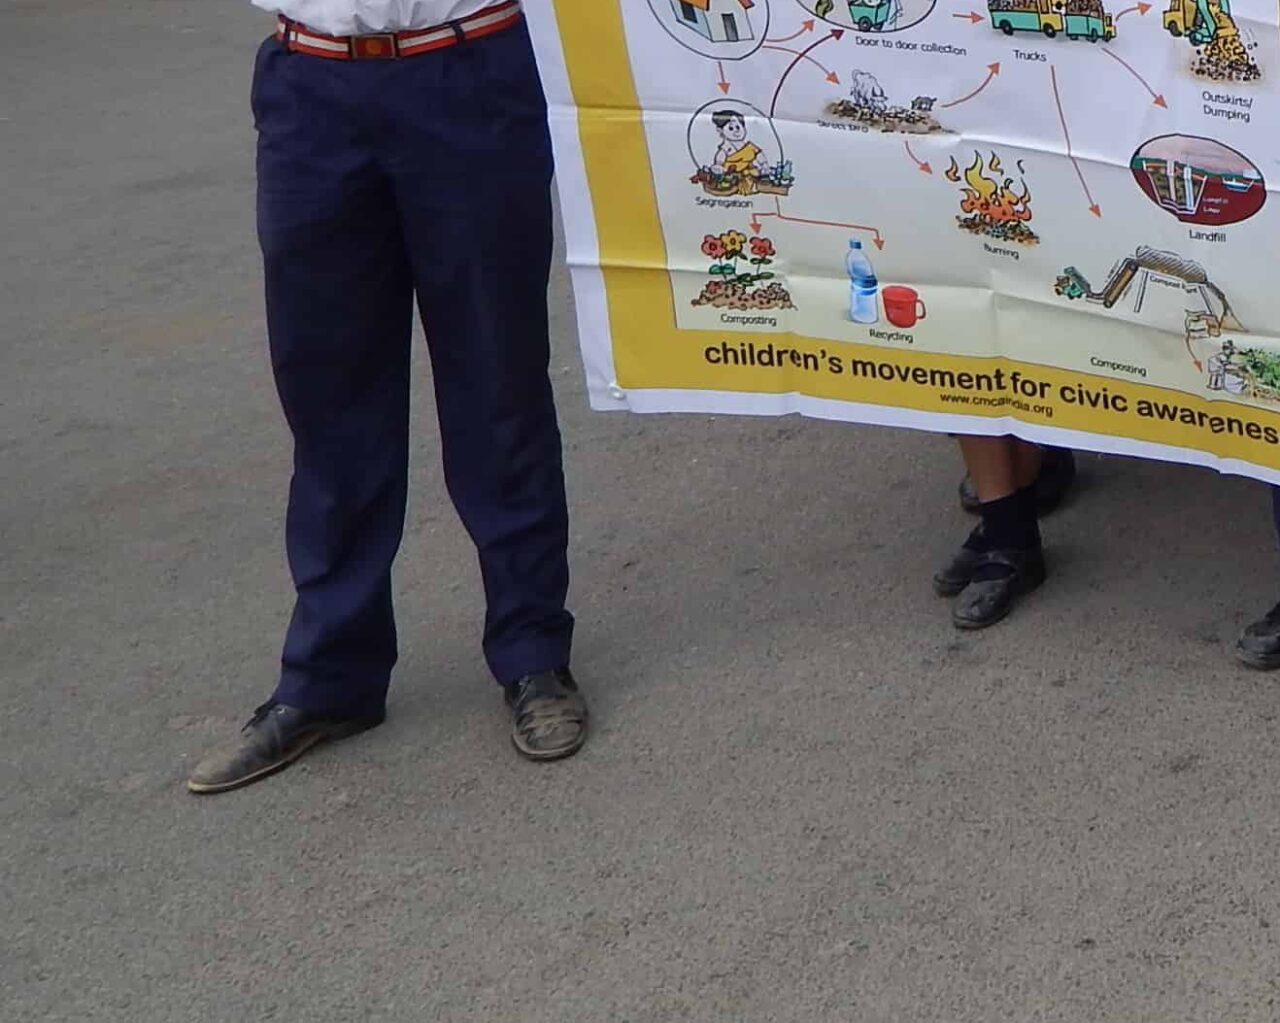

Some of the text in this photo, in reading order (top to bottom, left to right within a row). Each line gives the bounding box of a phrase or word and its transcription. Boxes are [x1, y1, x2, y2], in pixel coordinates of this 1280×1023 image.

[855, 35, 968, 57] Door to door collection
[1013, 49, 1048, 63] Trucks
[1202, 89, 1253, 109] Outskirts/
[1203, 104, 1251, 123] Dumping
[695, 195, 754, 210] Segregation
[1188, 228, 1227, 243] Landfill
[720, 313, 778, 328] Composting
[868, 328, 915, 345] Recycling
[1090, 356, 1148, 377] Composting
[704, 341, 844, 376] children's
[851, 357, 1006, 392] movement
[1010, 369, 1051, 399] for
[1059, 380, 1129, 414] civic
